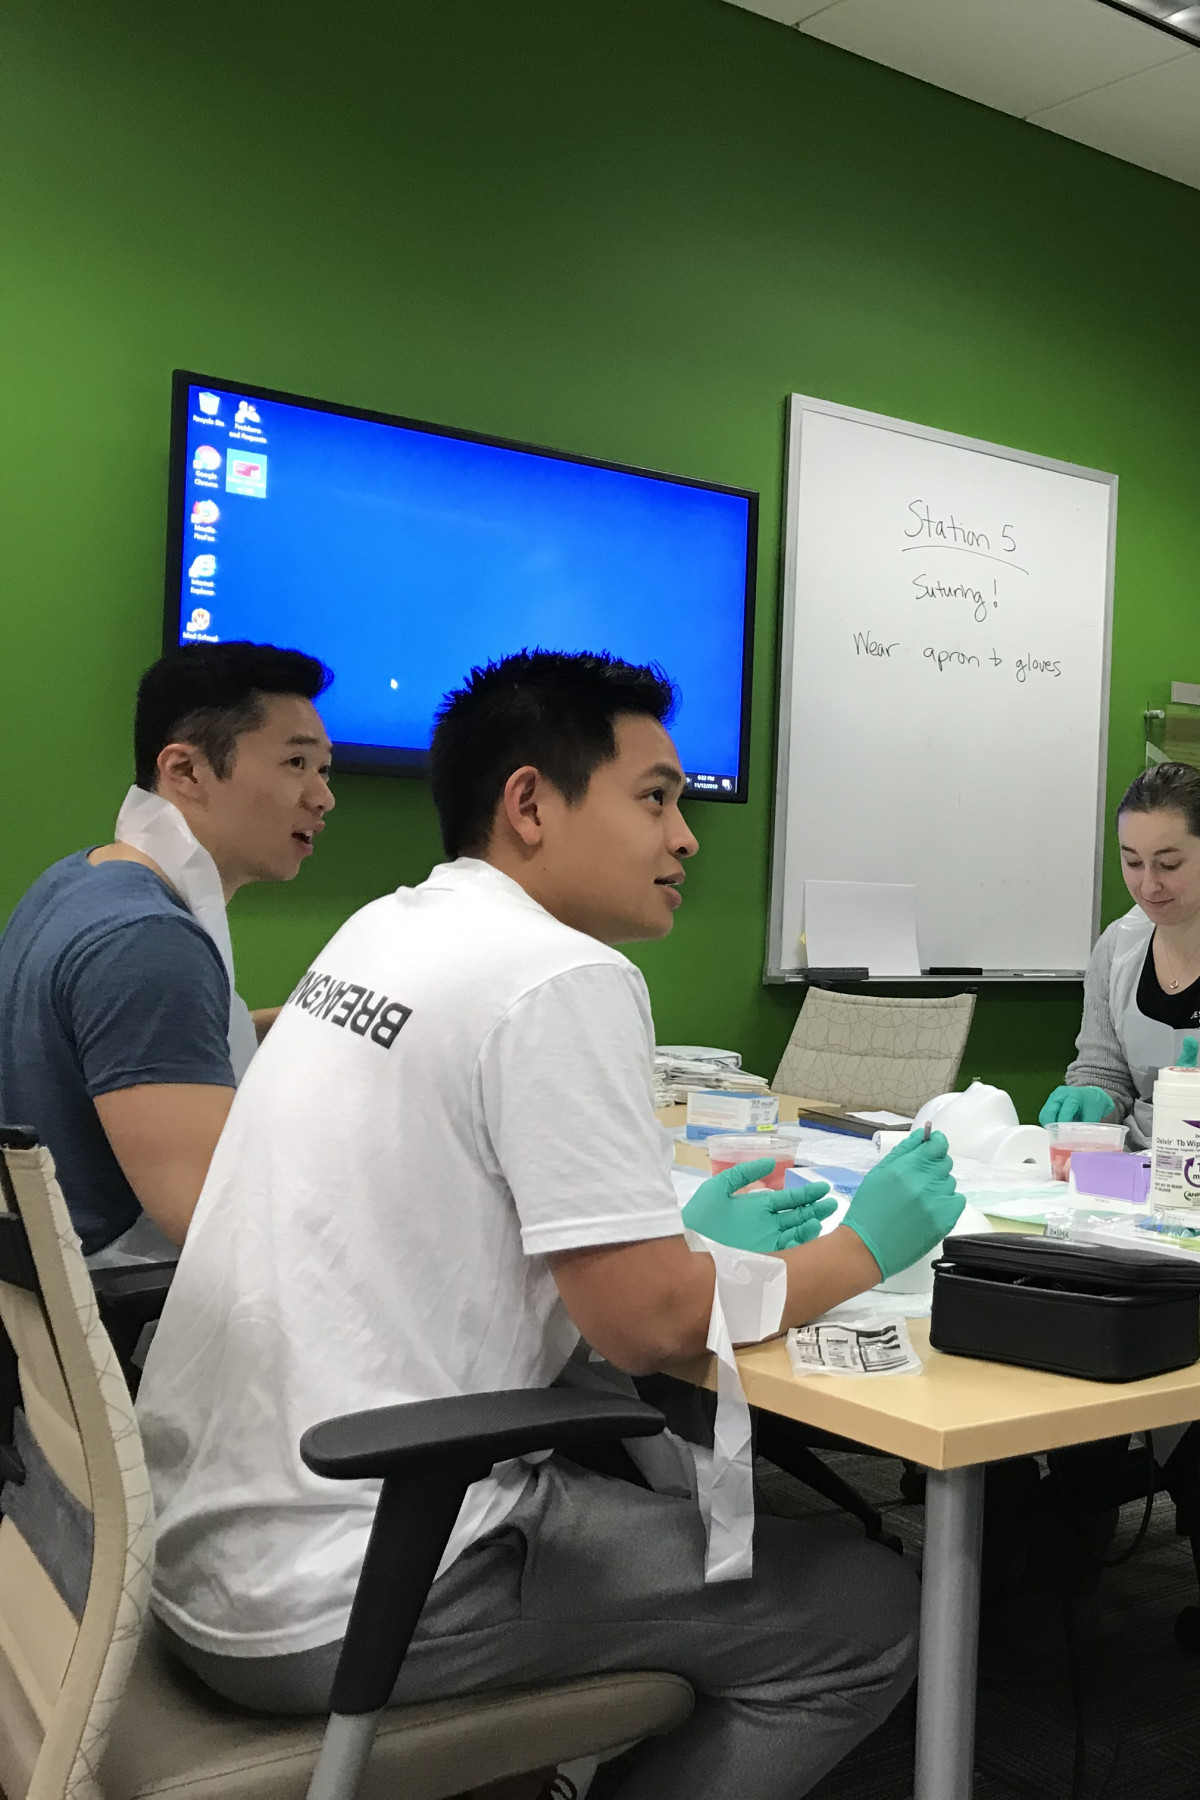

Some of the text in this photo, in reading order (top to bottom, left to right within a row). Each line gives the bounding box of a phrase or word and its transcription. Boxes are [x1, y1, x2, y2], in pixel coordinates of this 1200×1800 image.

[904, 499, 1016, 552] Station 5
[853, 630, 900, 656] Wear
[923, 646, 980, 671] apron
[1015, 652, 1061, 682] gloves
